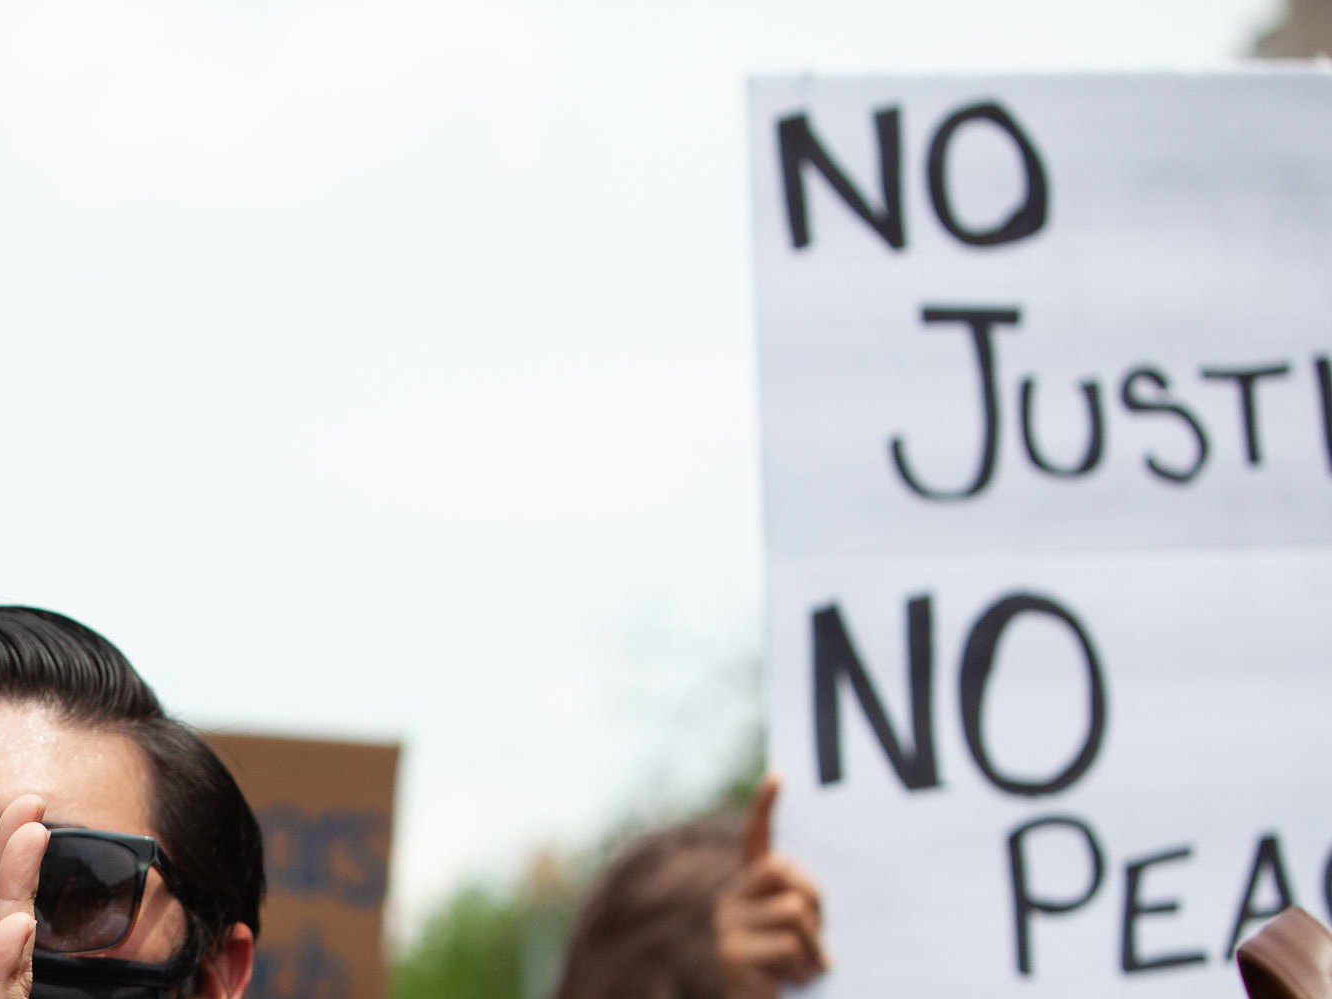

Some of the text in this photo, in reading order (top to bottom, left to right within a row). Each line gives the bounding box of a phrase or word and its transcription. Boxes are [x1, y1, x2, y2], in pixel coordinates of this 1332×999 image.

[775, 100, 1050, 252] NO
[811, 592, 1108, 799] NO
[1006, 814, 1332, 976] PEA
